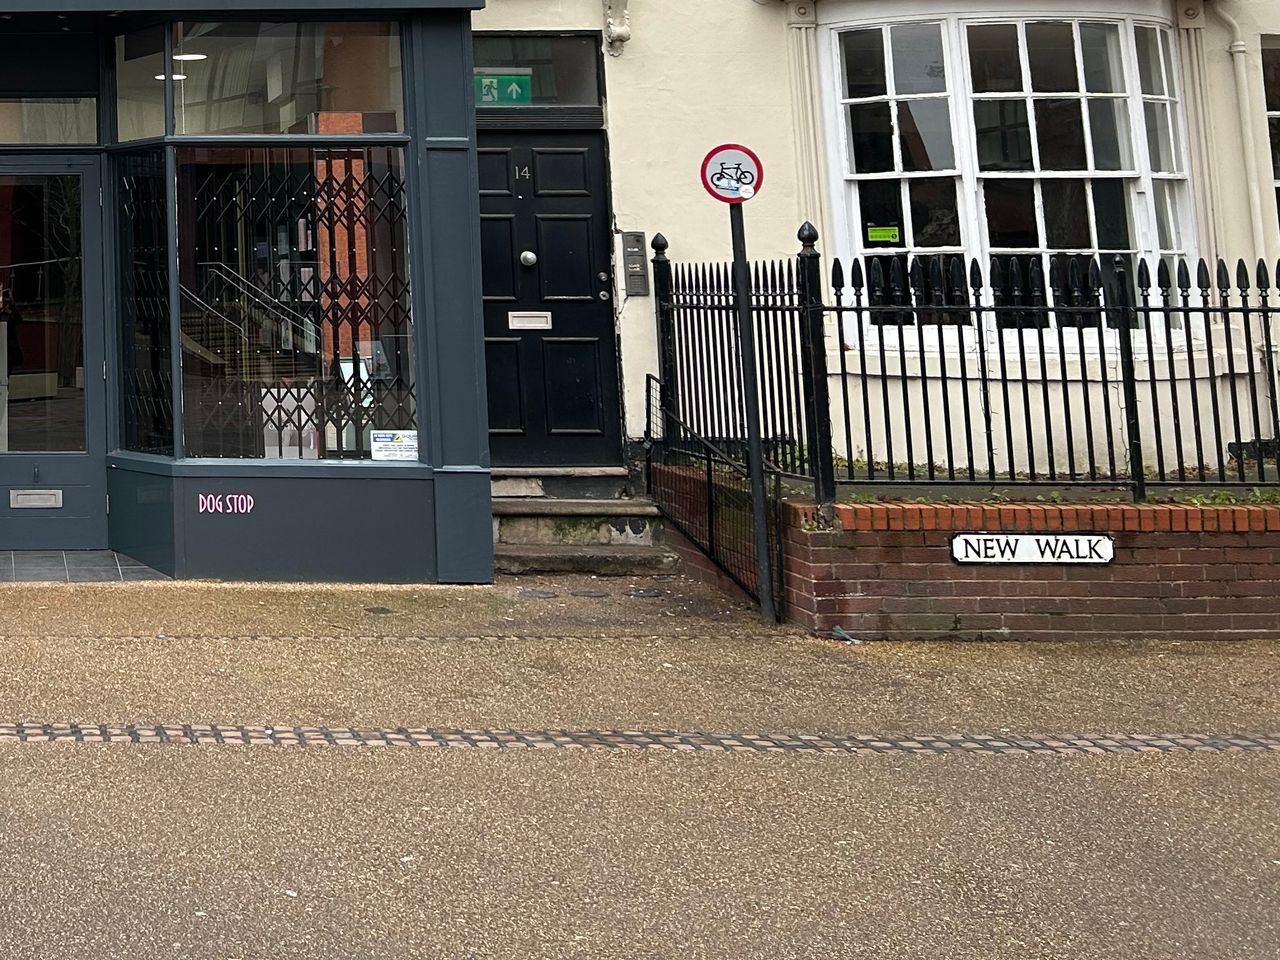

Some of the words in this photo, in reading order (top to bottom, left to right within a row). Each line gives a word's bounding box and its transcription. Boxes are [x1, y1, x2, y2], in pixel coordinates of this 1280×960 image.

[515, 166, 531, 179] 14
[198, 493, 223, 513] DOG
[226, 494, 254, 514] STOP
[962, 538, 1020, 559] NEW
[1034, 538, 1106, 560] WALK
